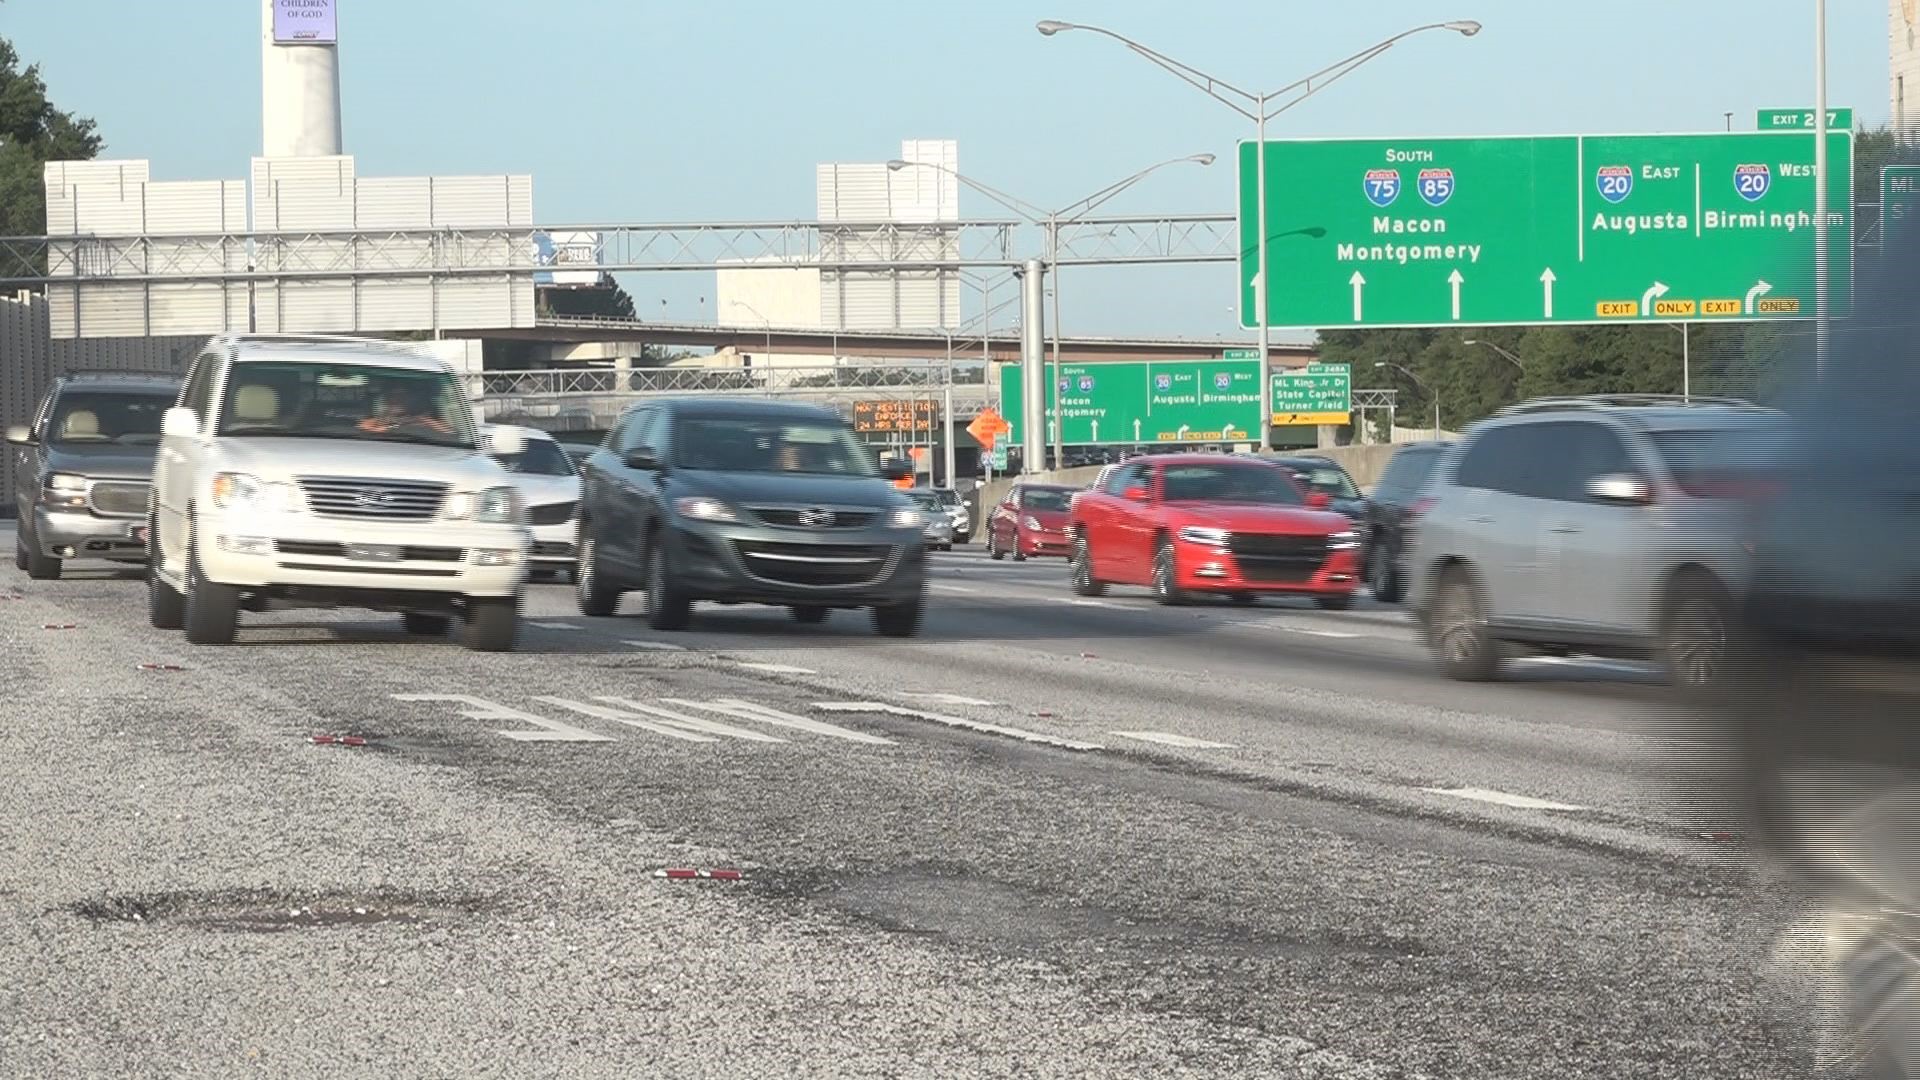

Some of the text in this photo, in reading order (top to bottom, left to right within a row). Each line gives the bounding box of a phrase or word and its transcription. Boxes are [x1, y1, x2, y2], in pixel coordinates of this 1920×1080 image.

[287, 10, 322, 18] OF GOD
[1772, 112, 1837, 127] EXIT 27
[1385, 148, 1433, 162] SOUTH
[1603, 165, 1680, 194] 20 EAST
[1740, 163, 1816, 192] 20 WEST
[1370, 179, 1449, 198] 75 85
[1373, 215, 1447, 234] Macon
[1592, 212, 1688, 235] Augusta
[1337, 243, 1481, 265] Montgomery
[1602, 302, 1693, 315] EXIT ONLY
[1706, 301, 1797, 313] EXIT ONLY
[1334, 379, 1346, 387] Dr
[1153, 396, 1196, 405] Augusta
[1276, 390, 1304, 399] State
[1279, 401, 1344, 410] Turner Field
